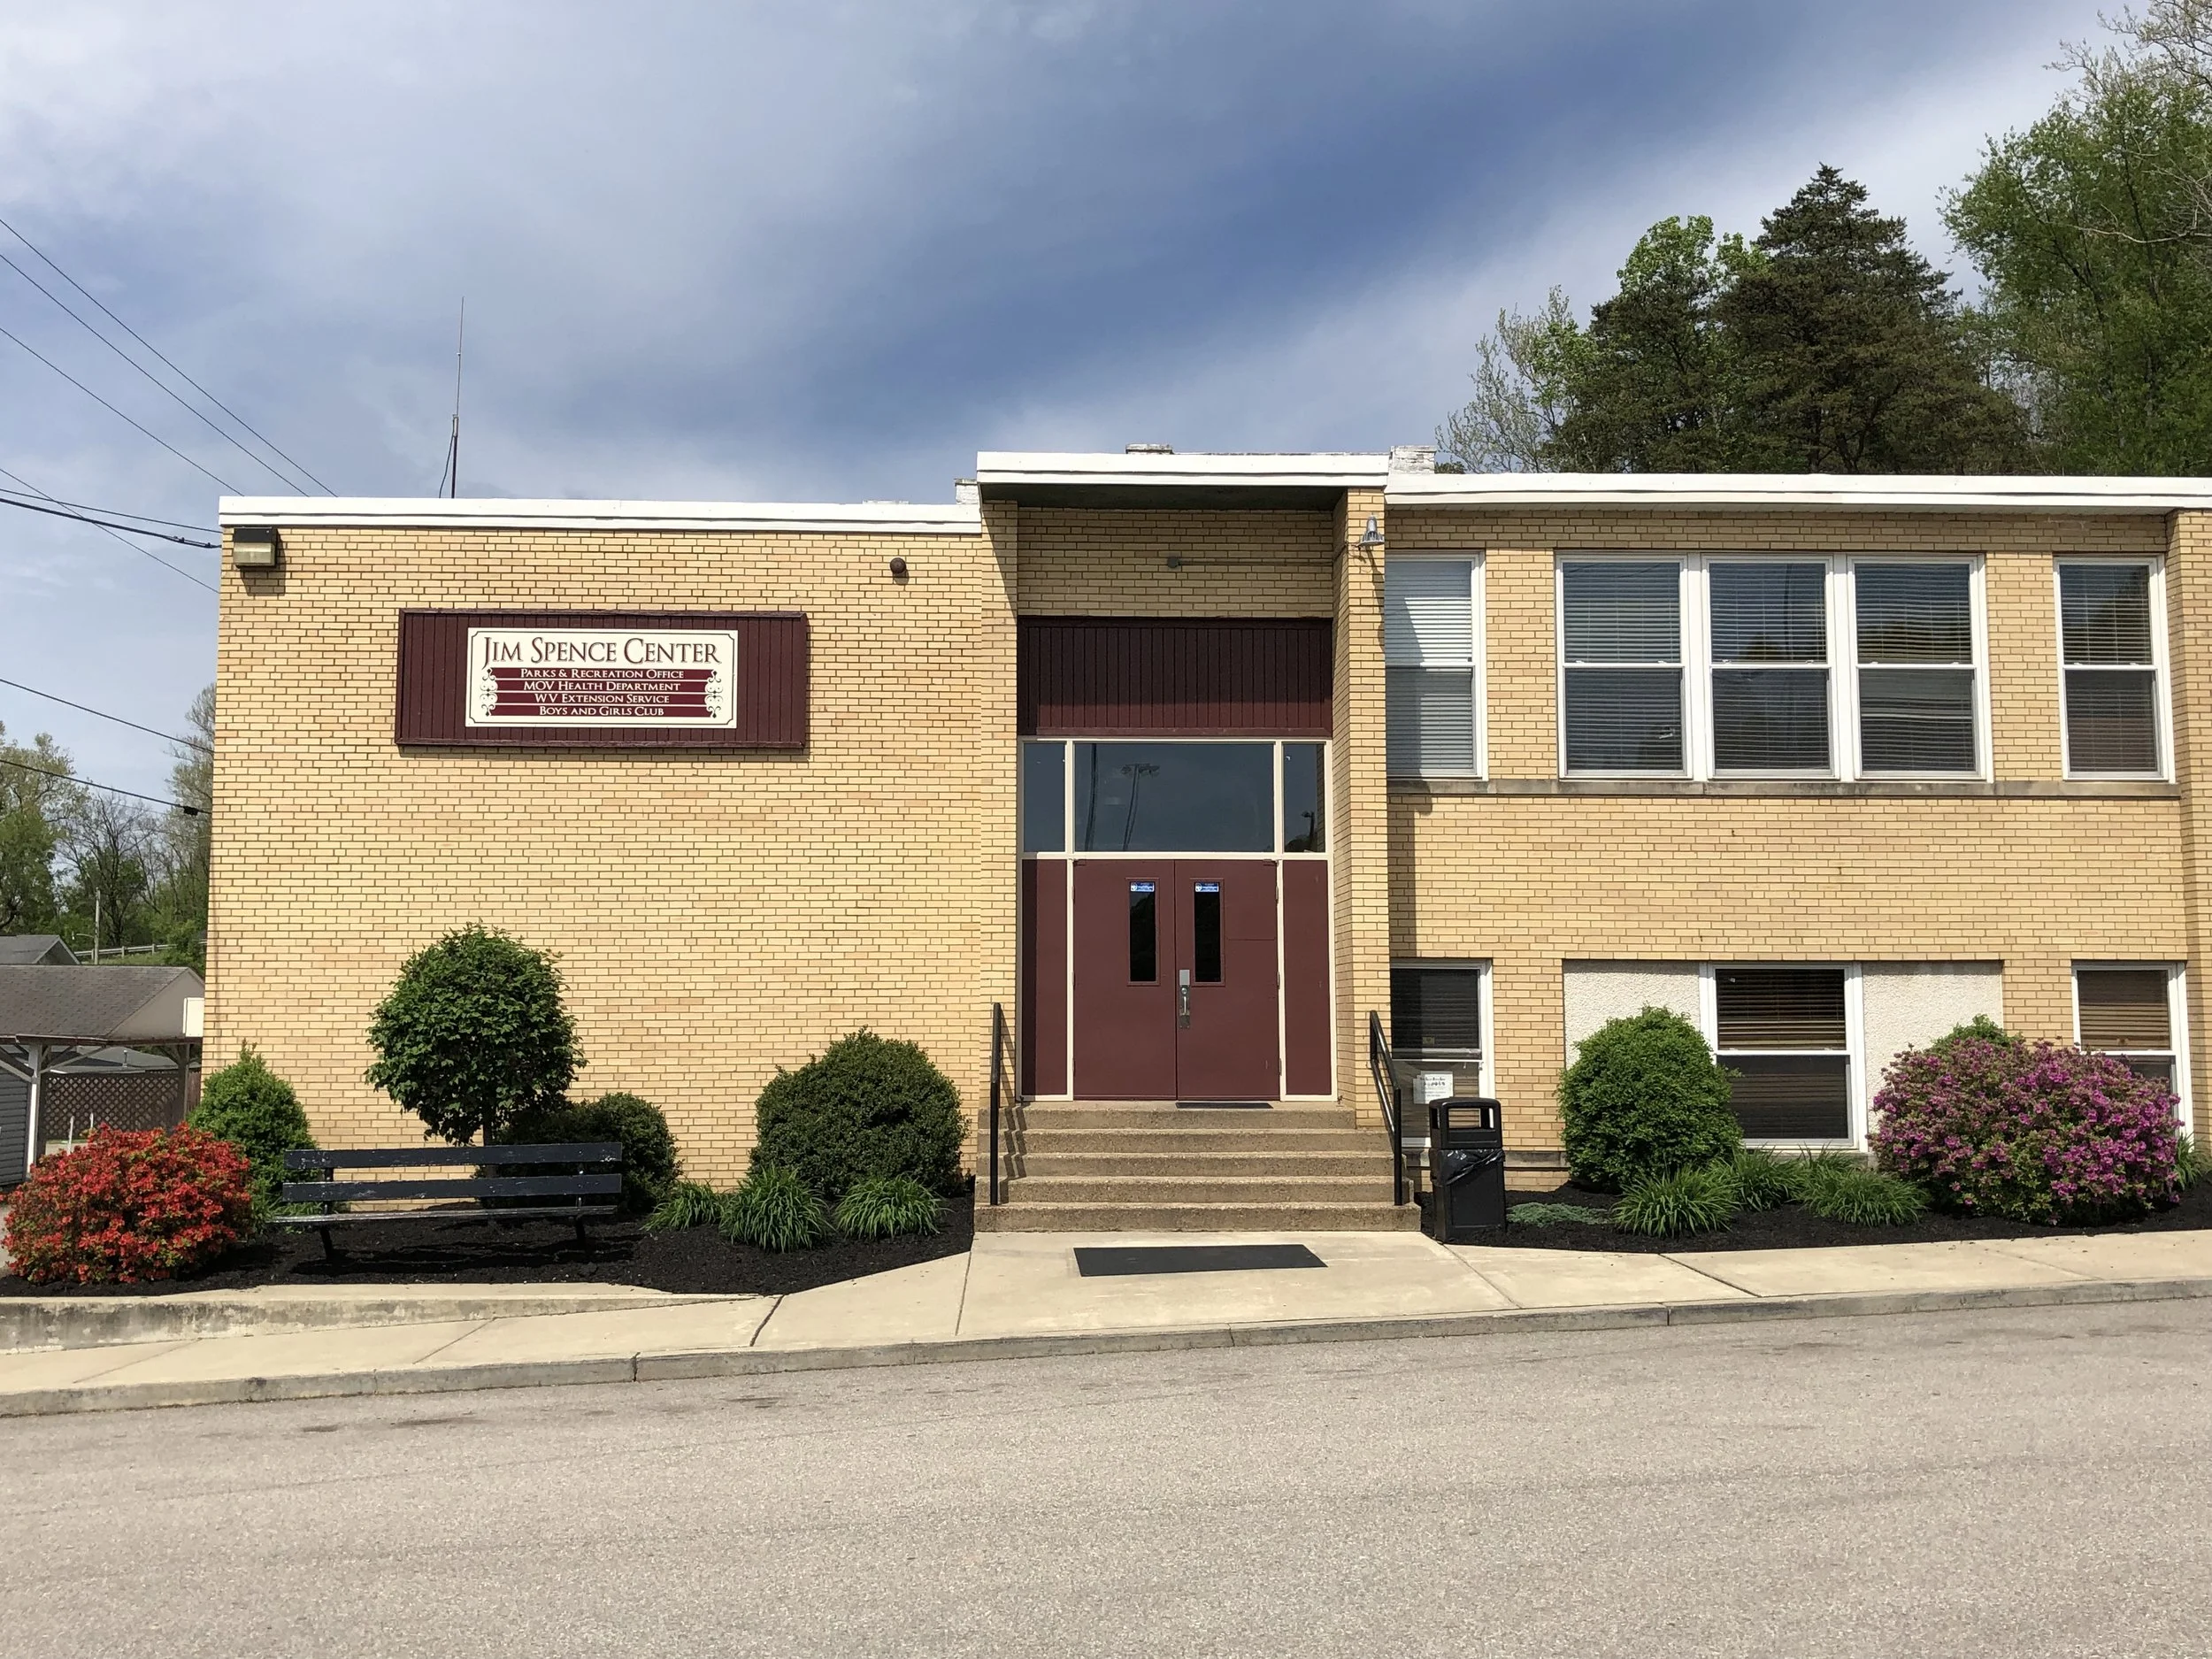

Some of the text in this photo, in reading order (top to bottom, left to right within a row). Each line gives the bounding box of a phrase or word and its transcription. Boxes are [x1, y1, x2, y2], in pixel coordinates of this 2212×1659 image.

[481, 636, 722, 670] JIM SPENCE CENTER
[520, 668, 684, 679] PARKS & RECREATION OFFICE
[524, 680, 680, 691] MOV HEALTH DEPARTMENT
[562, 693, 624, 703] EXTENSION
[626, 694, 670, 703] SERVICE
[539, 706, 567, 716] BOYS
[599, 706, 632, 716] GIRLS
[634, 706, 664, 716] CLUB
